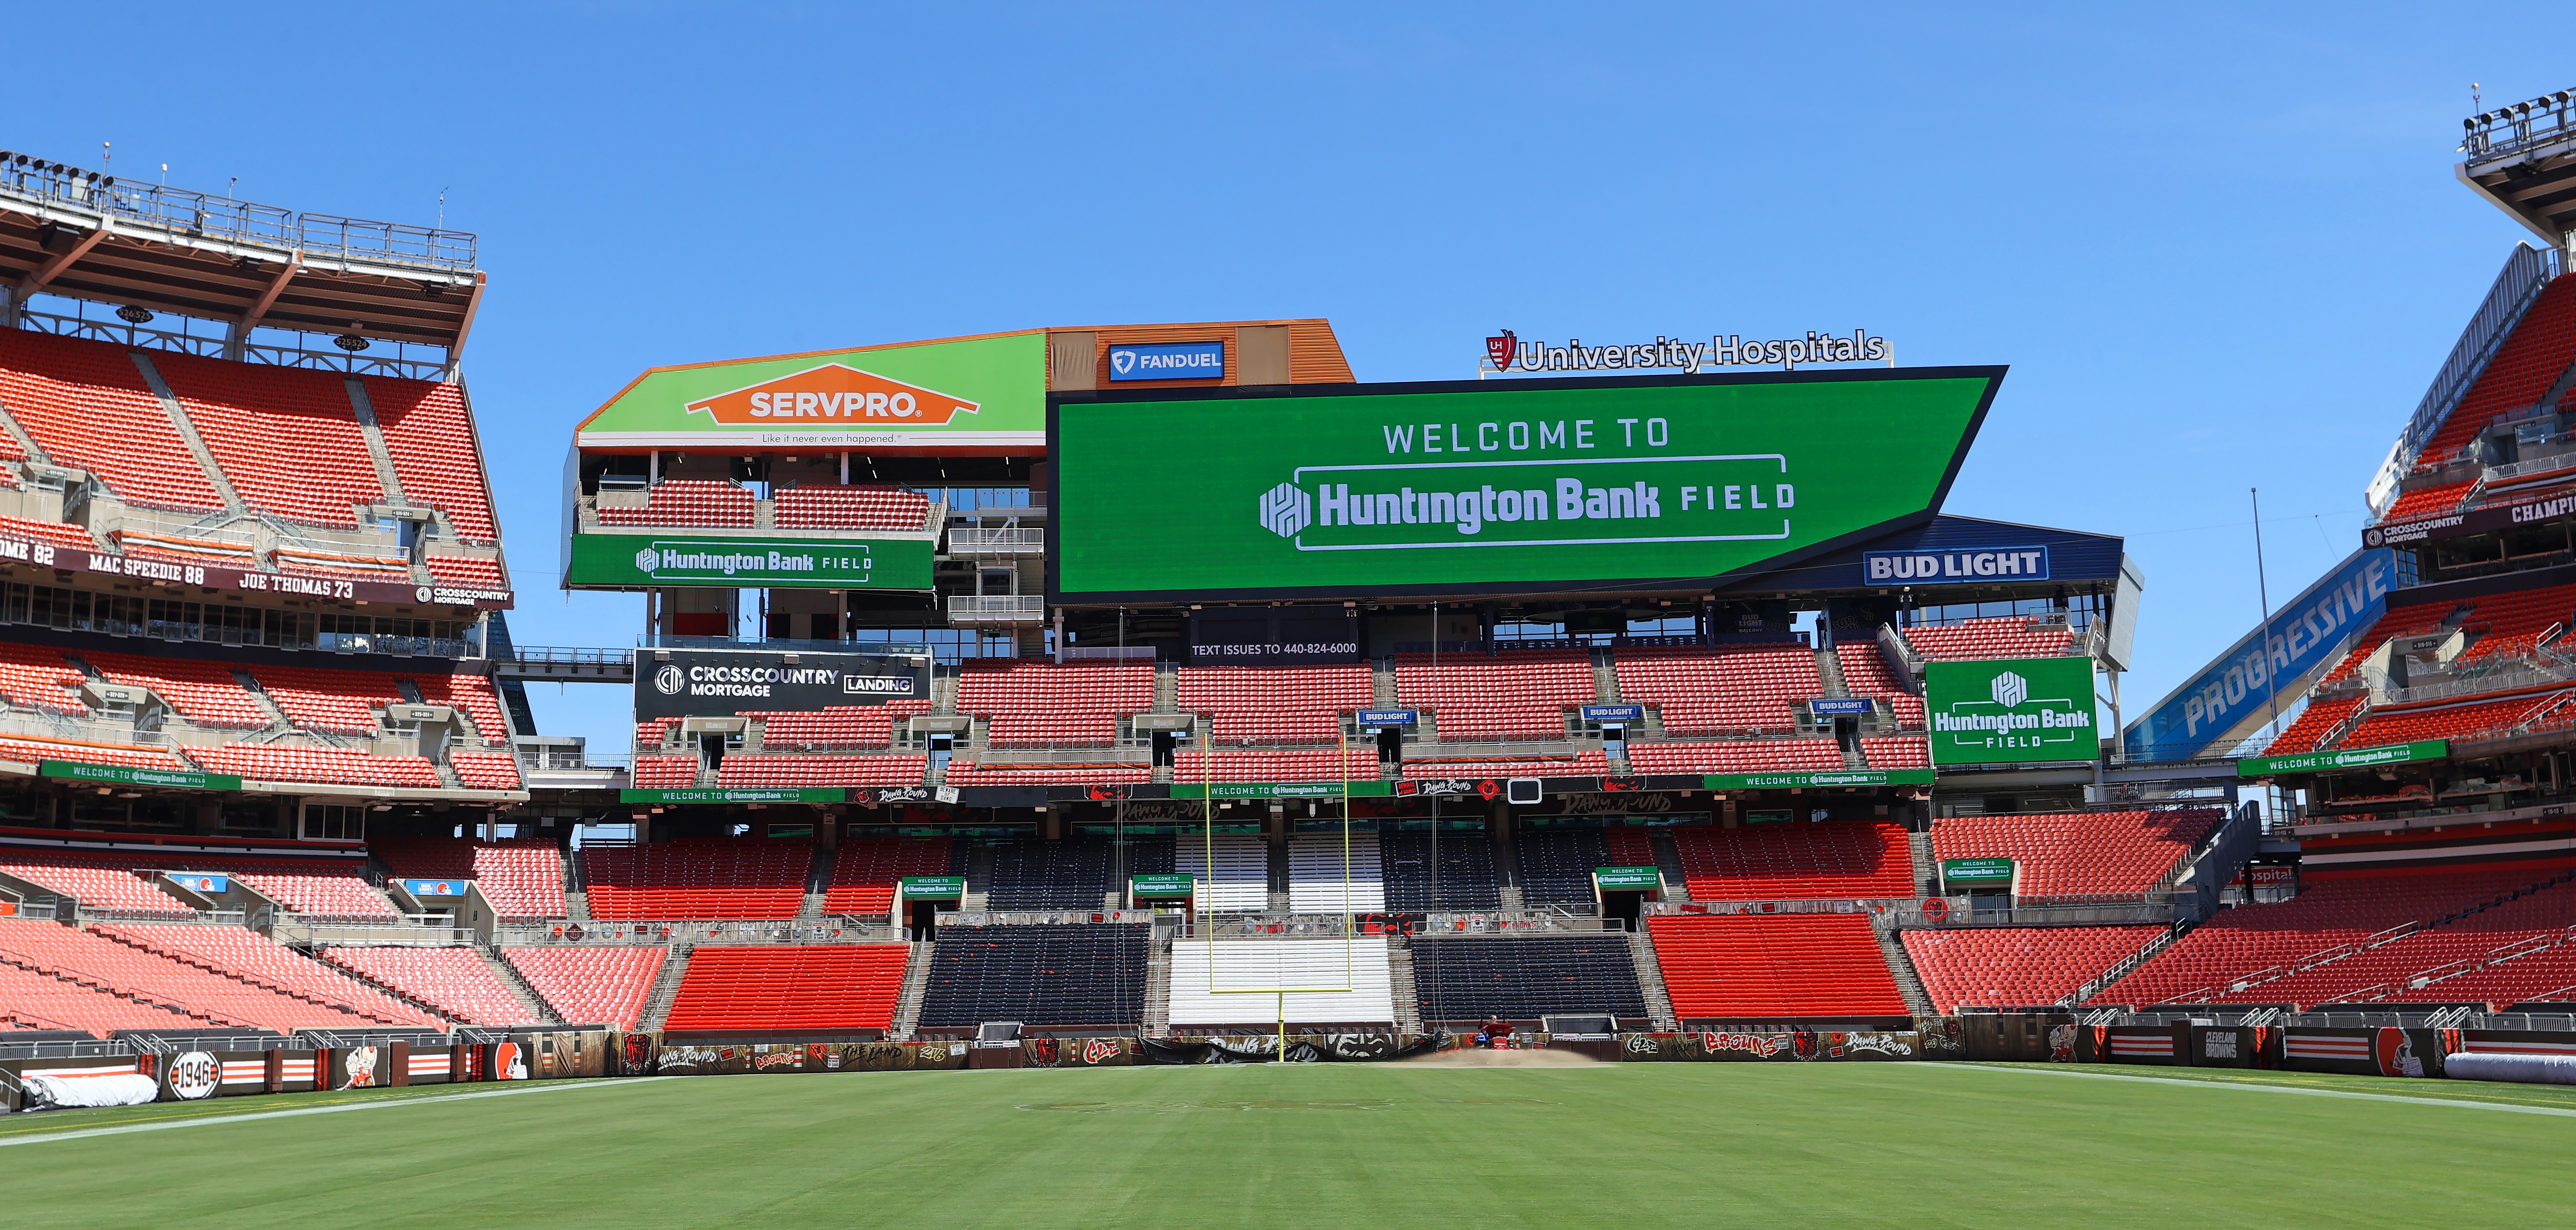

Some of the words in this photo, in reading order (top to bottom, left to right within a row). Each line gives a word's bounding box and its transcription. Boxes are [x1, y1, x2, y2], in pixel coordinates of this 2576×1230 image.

[1141, 353, 1221, 368] FANDUEL
[1520, 335, 1705, 373] University
[1714, 329, 1884, 370] Hospitals
[1384, 421, 1594, 453] WELCOME
[1617, 418, 1667, 447] TO
[1319, 484, 1548, 534] Huntington
[1557, 478, 1660, 520] Bank
[1682, 484, 1794, 510] FIELD
[2512, 496, 2576, 523] CHAMPI
[2383, 515, 2464, 536] CROSSCOUNTRY
[2385, 531, 2429, 544] MORTGAGE
[34, 544, 55, 565] 82
[663, 550, 764, 575] Huntington
[768, 552, 814, 570] Bank
[823, 557, 872, 569] FIELD
[89, 554, 121, 573] MAC
[124, 559, 182, 582] SPEEDIE
[184, 566, 205, 586] 88
[1870, 555, 1939, 579] BUD
[1944, 552, 2041, 577] LIGHT
[239, 573, 267, 590] JOE
[269, 575, 331, 596] THOMAS
[334, 581, 354, 599] 73
[434, 588, 509, 601] CROSSCOUNTRY
[434, 596, 475, 606] MORTGAGE
[1192, 645, 1221, 655] TEXT
[1224, 644, 1261, 655] ISSUES
[1264, 644, 1280, 654] TO
[1284, 643, 1356, 653] 440-824-6000
[2184, 559, 2387, 737] PROGRESSIVE
[690, 667, 839, 685] CROSSCOUNTRY
[848, 679, 910, 691] LANDING
[691, 685, 770, 697] MORTGAGE
[1935, 712, 2038, 734] Huntington
[2042, 709, 2089, 728] Bank
[1987, 736, 2041, 748] FIELD
[2269, 758, 2316, 770] WELCOME
[2344, 752, 2377, 763] Huntington
[2377, 751, 2392, 759] Bank
[73, 767, 115, 778] WELCOME
[119, 771, 129, 780] TO
[140, 772, 170, 783] Huntington
[171, 775, 186, 783] Bank
[1819, 775, 1852, 784] Huntington
[734, 792, 765, 800] Huntington
[878, 788, 901, 802] DAWG
[901, 787, 928, 799] POUND
[1280, 787, 1312, 796] Huntington
[1421, 781, 1445, 794] DAWG
[1445, 779, 1471, 791] POUND
[1627, 1033, 1659, 1053] CLE
[1704, 1032, 1779, 1058] BROWNS
[1845, 1031, 1877, 1052] DAWG
[1877, 1033, 1912, 1055] POUND
[2206, 1031, 2237, 1044] CLEVELAND
[755, 1051, 795, 1070] BROWNS
[843, 1045, 867, 1058] THE
[867, 1047, 902, 1062] LAND
[1083, 1039, 1121, 1063] CLE
[2206, 1044, 2237, 1058] BROWNS
[180, 1061, 209, 1088] 1946
